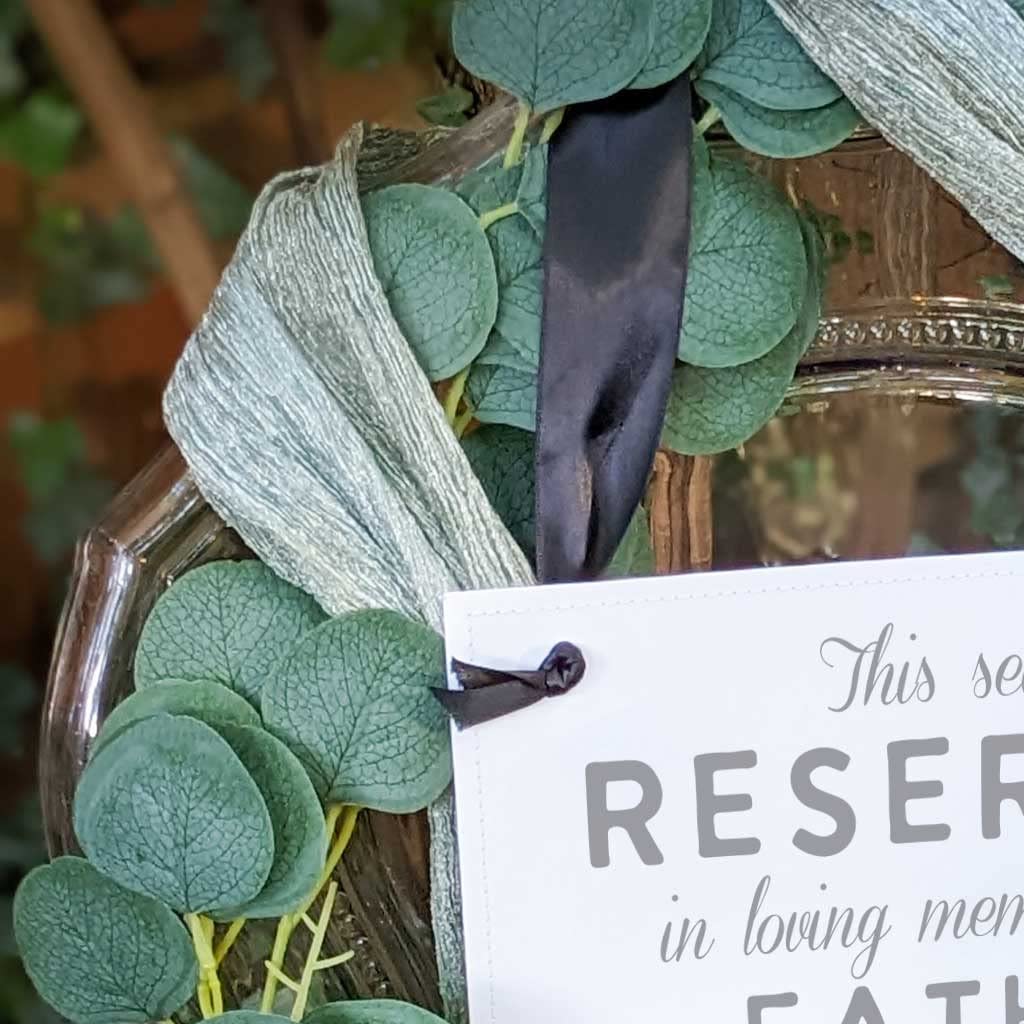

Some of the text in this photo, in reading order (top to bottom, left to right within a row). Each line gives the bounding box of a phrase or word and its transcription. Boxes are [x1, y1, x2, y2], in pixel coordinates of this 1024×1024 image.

[819, 622, 936, 713] This
[659, 894, 716, 964] in
[743, 874, 893, 980] loving
